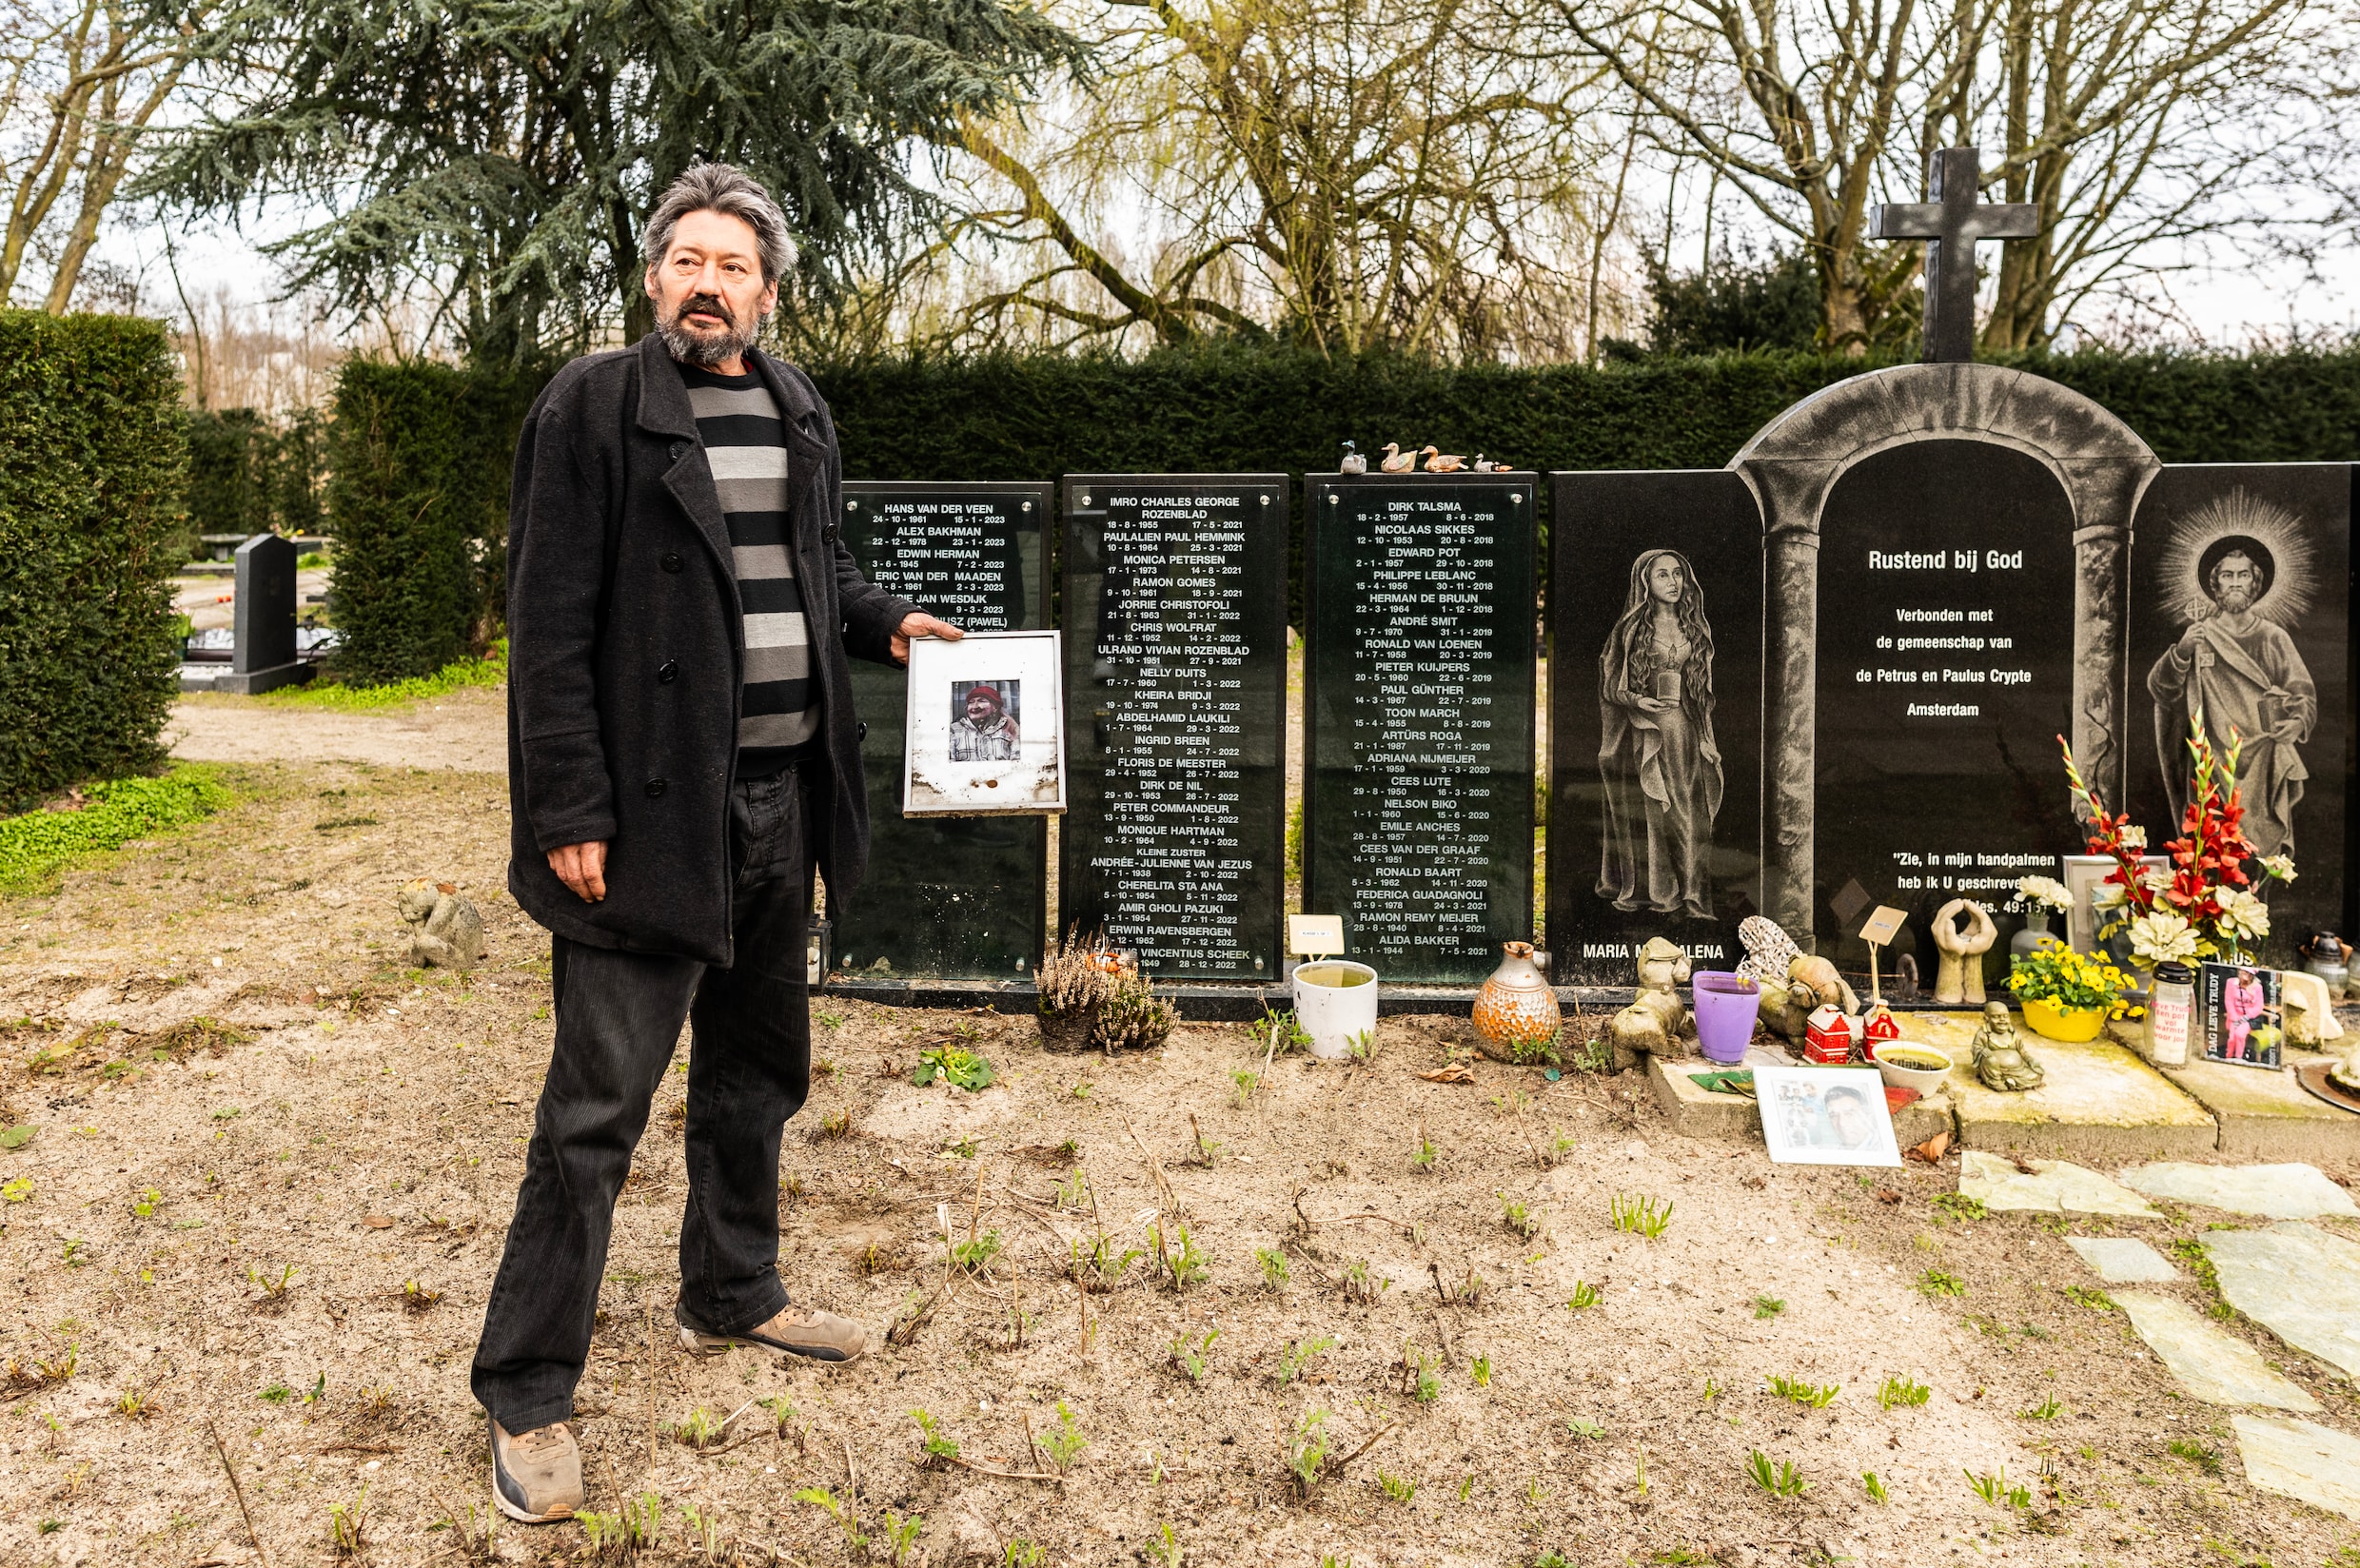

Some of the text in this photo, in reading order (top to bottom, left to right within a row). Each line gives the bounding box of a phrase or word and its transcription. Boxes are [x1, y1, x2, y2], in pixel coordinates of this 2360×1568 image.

[1111, 498, 1239, 506] IMRO CHARLES GEORGE
[1388, 502, 1462, 511] DIRK TALSMA
[885, 504, 993, 514] HANS VAN DER VEEN
[1142, 510, 1208, 519] ROZENBLAD
[896, 527, 981, 536] ALEX BAKHMAN
[1375, 525, 1475, 534] NICOLAAS SIKKES
[1104, 533, 1245, 541] PAULALIEN PAUL HEMMINK
[897, 549, 979, 559] EDWIN HERMAN
[1388, 548, 1461, 557] EDWARD POT
[1124, 556, 1225, 564] MONICA PETERSEN
[1869, 550, 2022, 573] Rustend bij God
[875, 572, 1001, 581] ERIC VAN DER MAADEN
[1374, 571, 1476, 579] PHILIPPE LEBLANC
[1133, 578, 1215, 587] RAMON GOMES
[916, 595, 936, 603] JAN
[940, 595, 987, 603] WESDIJK
[1370, 594, 1478, 603] HERMAN DE BRUIJN
[1118, 600, 1229, 609] JORRIE CHRISTOFOLI
[1390, 615, 1458, 625] ANDRÉ SMIT
[1897, 609, 1993, 621] Verbonden met
[967, 617, 1007, 628] (PAWEL)
[1131, 623, 1217, 632] CHRIS WOLFRAT
[1366, 639, 1482, 649] RONALD VAN LOENEN
[1877, 636, 2012, 651] de gemeenschap van
[1098, 645, 1249, 655] ULRAND VIVIAN ROZENBLAD
[1140, 667, 1206, 677] NELLY DUITS
[1376, 662, 1470, 672] PIETER KUIJPERS
[1857, 669, 2031, 685] de Petrus en Paulus Crypte
[1382, 684, 1464, 695] PAUL GÜNTHER
[1135, 691, 1211, 700] KHEIRA BRIDJI
[1385, 709, 1460, 717] TOON MARCH
[1907, 703, 1978, 715] Amsterdam
[1116, 713, 1229, 723] ABDELHAMID LAUKILI
[1135, 735, 1210, 745] INGRID BREEN
[1430, 732, 1462, 740] ROGA
[1118, 758, 1226, 768] FLORIS DE MEESTER
[1367, 754, 1476, 763] ADRIANA NIJMEIJER
[1140, 781, 1165, 790] DIRK
[1169, 781, 1183, 790] DE
[1391, 776, 1451, 786] CEES LUTE
[1113, 803, 1229, 813] PETER COMMANDEUR
[1385, 799, 1457, 809] NELSON BIKO
[1118, 826, 1224, 835] MONIQUE HARTMAN
[1381, 822, 1460, 832] EMILE ANCHES
[1360, 844, 1481, 854] CEES VAN DER GRAAF
[1218, 860, 1252, 869] JEZUS
[1928, 853, 1939, 865] in
[1945, 853, 1972, 868] mijn
[1977, 853, 2055, 868] handpalmen
[1376, 868, 1462, 876] RONALD BAART
[1118, 881, 1223, 891] CHERELITA STA ANA
[1898, 876, 2020, 892] heb ik U geschreve
[1357, 891, 1483, 899] FEDERICA GUADAGNOLI
[1118, 903, 1223, 913] AMIR GHOLI PAZUKI
[1360, 912, 1478, 922] RAMON REMY MEIJER
[1110, 926, 1231, 936] ERWIN RAVENSBERGEN
[1415, 936, 1459, 945] BAKKER
[1141, 949, 1204, 959] VINCENTIUS
[1207, 950, 1249, 959] SCHEEK
[1583, 944, 1723, 958] MARIA MALENA
[2209, 973, 2219, 1052] DAG LIEVE TRUDY
